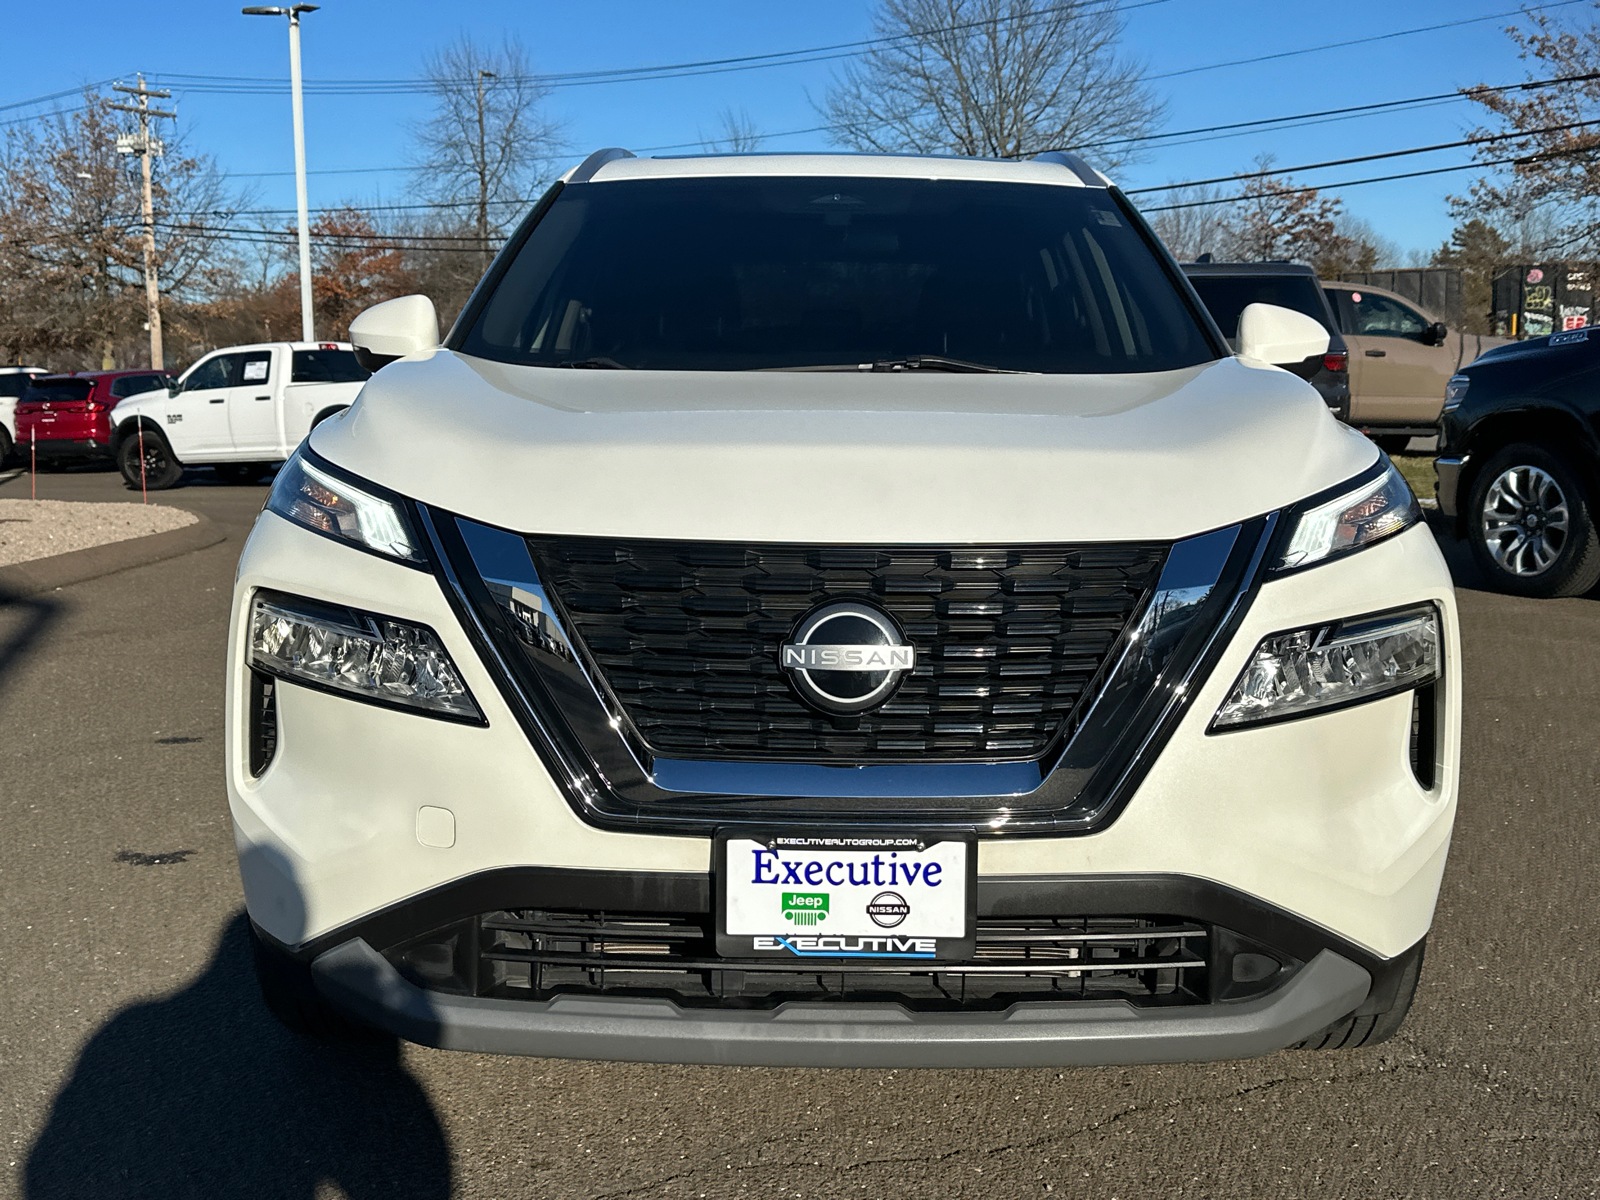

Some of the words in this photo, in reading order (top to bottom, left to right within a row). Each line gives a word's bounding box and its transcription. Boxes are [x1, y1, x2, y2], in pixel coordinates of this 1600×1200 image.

[786, 648, 909, 666] NISSAN
[776, 837, 918, 846] EXECUTIVEAUTOGROUP.COM
[751, 849, 943, 887] Executive
[788, 894, 823, 909] Jeep
[869, 905, 908, 914] NISSAN
[753, 936, 937, 953] EXECUTIVE
